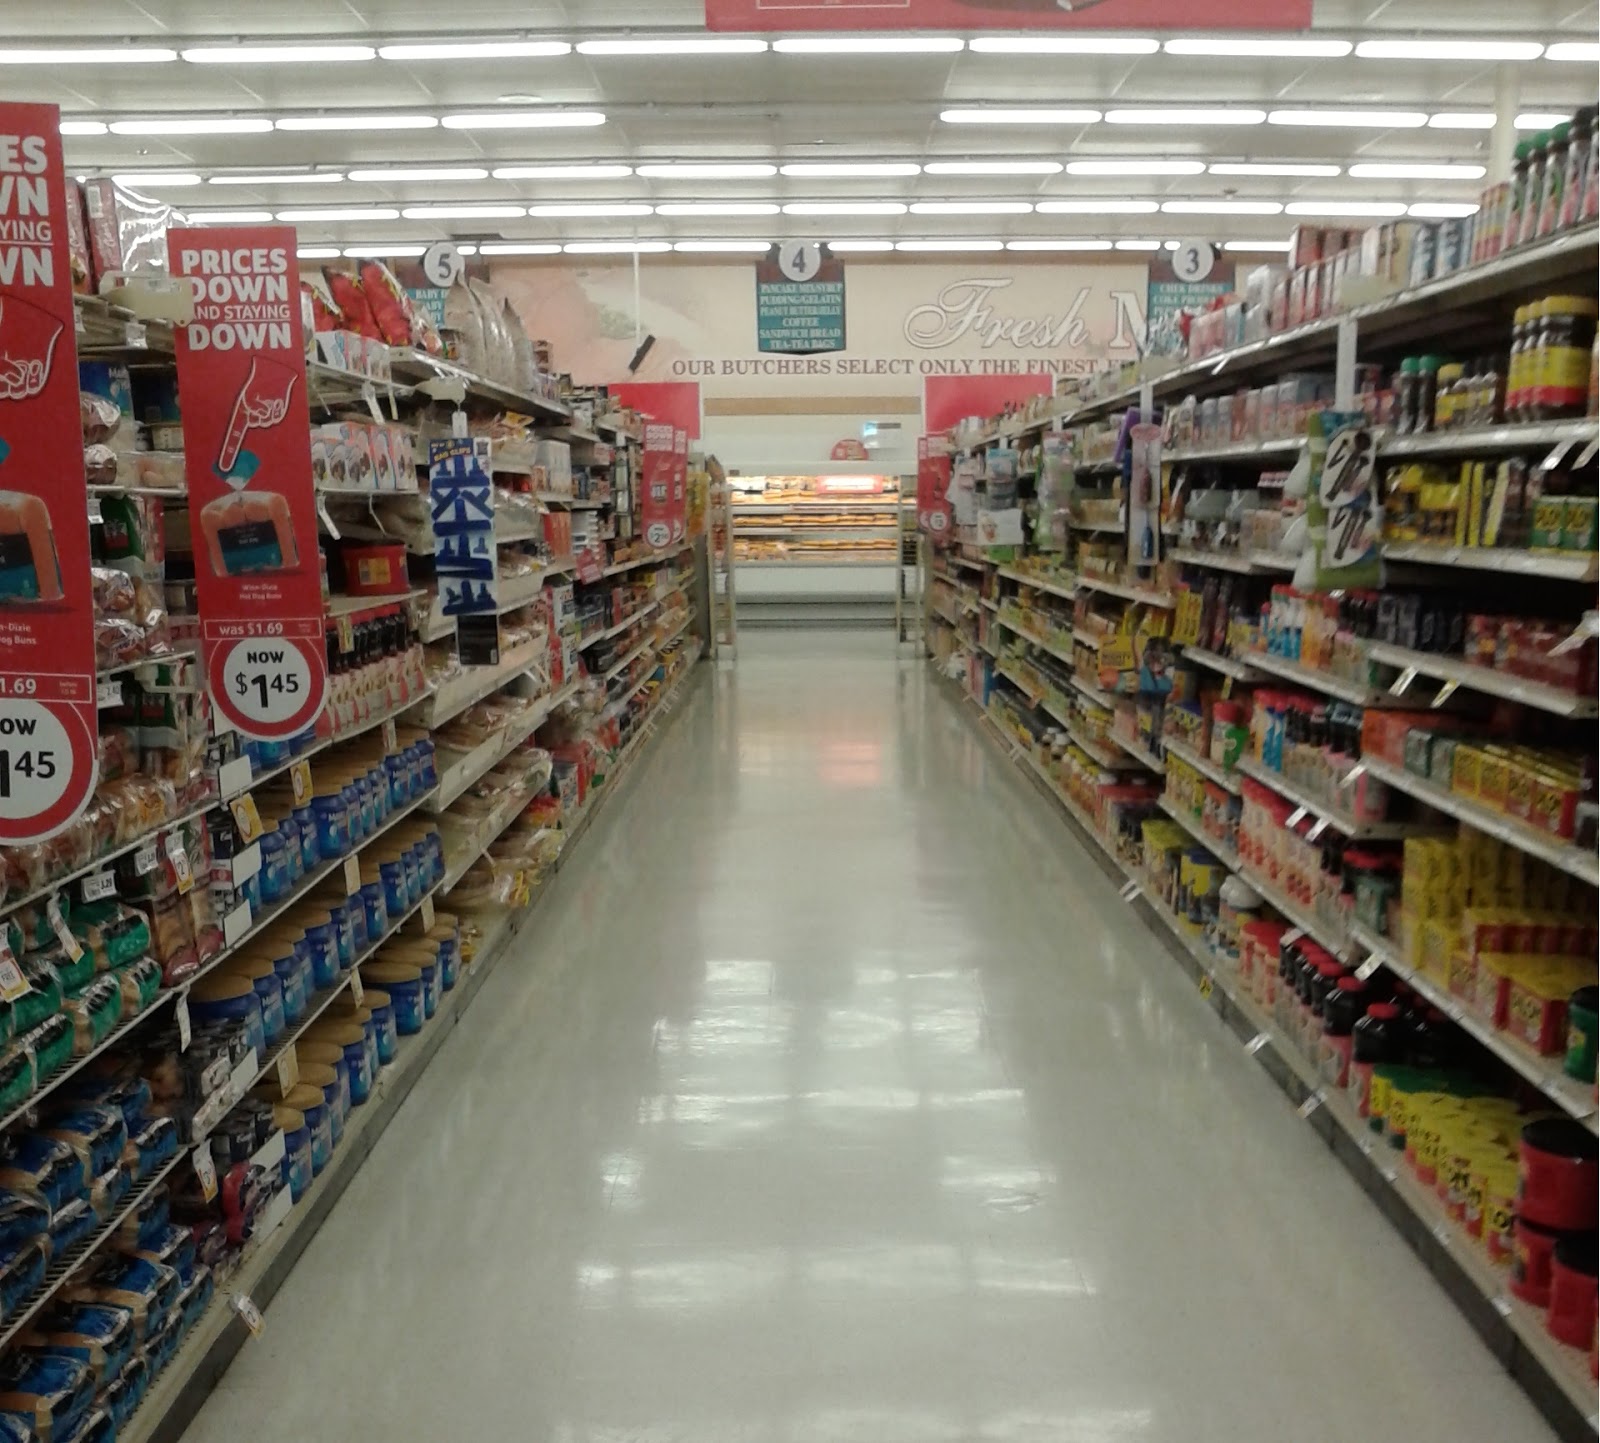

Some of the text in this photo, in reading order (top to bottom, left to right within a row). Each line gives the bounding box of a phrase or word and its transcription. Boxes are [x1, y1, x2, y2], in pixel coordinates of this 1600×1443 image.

[0, 220, 53, 242] YING
[181, 247, 288, 275] PRICES
[437, 253, 452, 279] 5
[791, 245, 807, 274] 4
[1185, 248, 1200, 274] 3
[190, 274, 288, 304] DOWN
[415, 289, 438, 300] BABY
[224, 304, 291, 320] STAYING
[903, 277, 1092, 350] Fresh
[782, 317, 819, 327] COFFEE
[187, 321, 292, 351] DOWN
[759, 327, 841, 339] SANDWICH BREAD
[672, 359, 715, 375] OUR
[721, 359, 831, 375] BUTCHERS
[836, 359, 915, 375] SELECT
[919, 358, 973, 374] ONLY
[979, 358, 1019, 374] THE
[1027, 358, 1098, 374] FINEST
[219, 622, 283, 636] was $1.69
[14, 635, 36, 645] Buns
[247, 651, 284, 664] NOW
